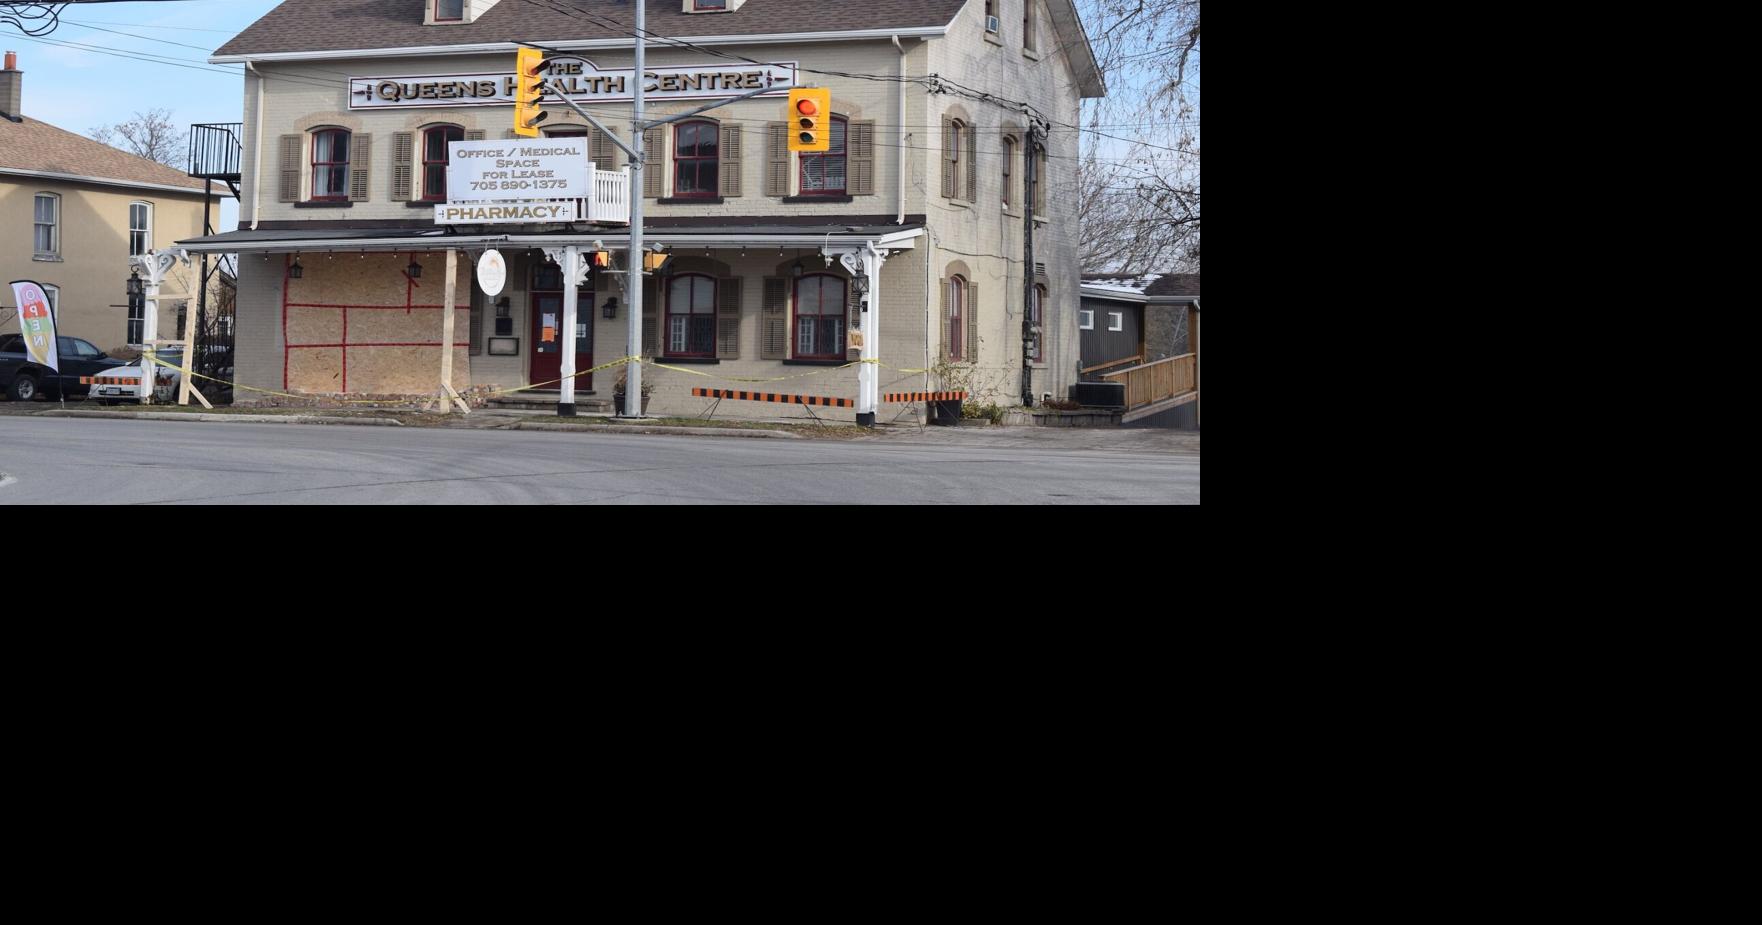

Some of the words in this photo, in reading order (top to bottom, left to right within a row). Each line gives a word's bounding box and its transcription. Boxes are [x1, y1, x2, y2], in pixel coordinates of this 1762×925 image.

[548, 62, 583, 75] THE
[376, 80, 496, 102] QUEENS
[504, 75, 625, 96] HALTH
[634, 70, 763, 93] CENTRE
[457, 149, 504, 159] OFFICE
[508, 147, 516, 157] /
[520, 147, 580, 157] MEDICAL
[496, 159, 540, 168] SPACE
[511, 170, 554, 179] LEASE
[470, 181, 498, 190] 705
[500, 180, 567, 190] 890-1375
[446, 206, 561, 220] PHARMACY
